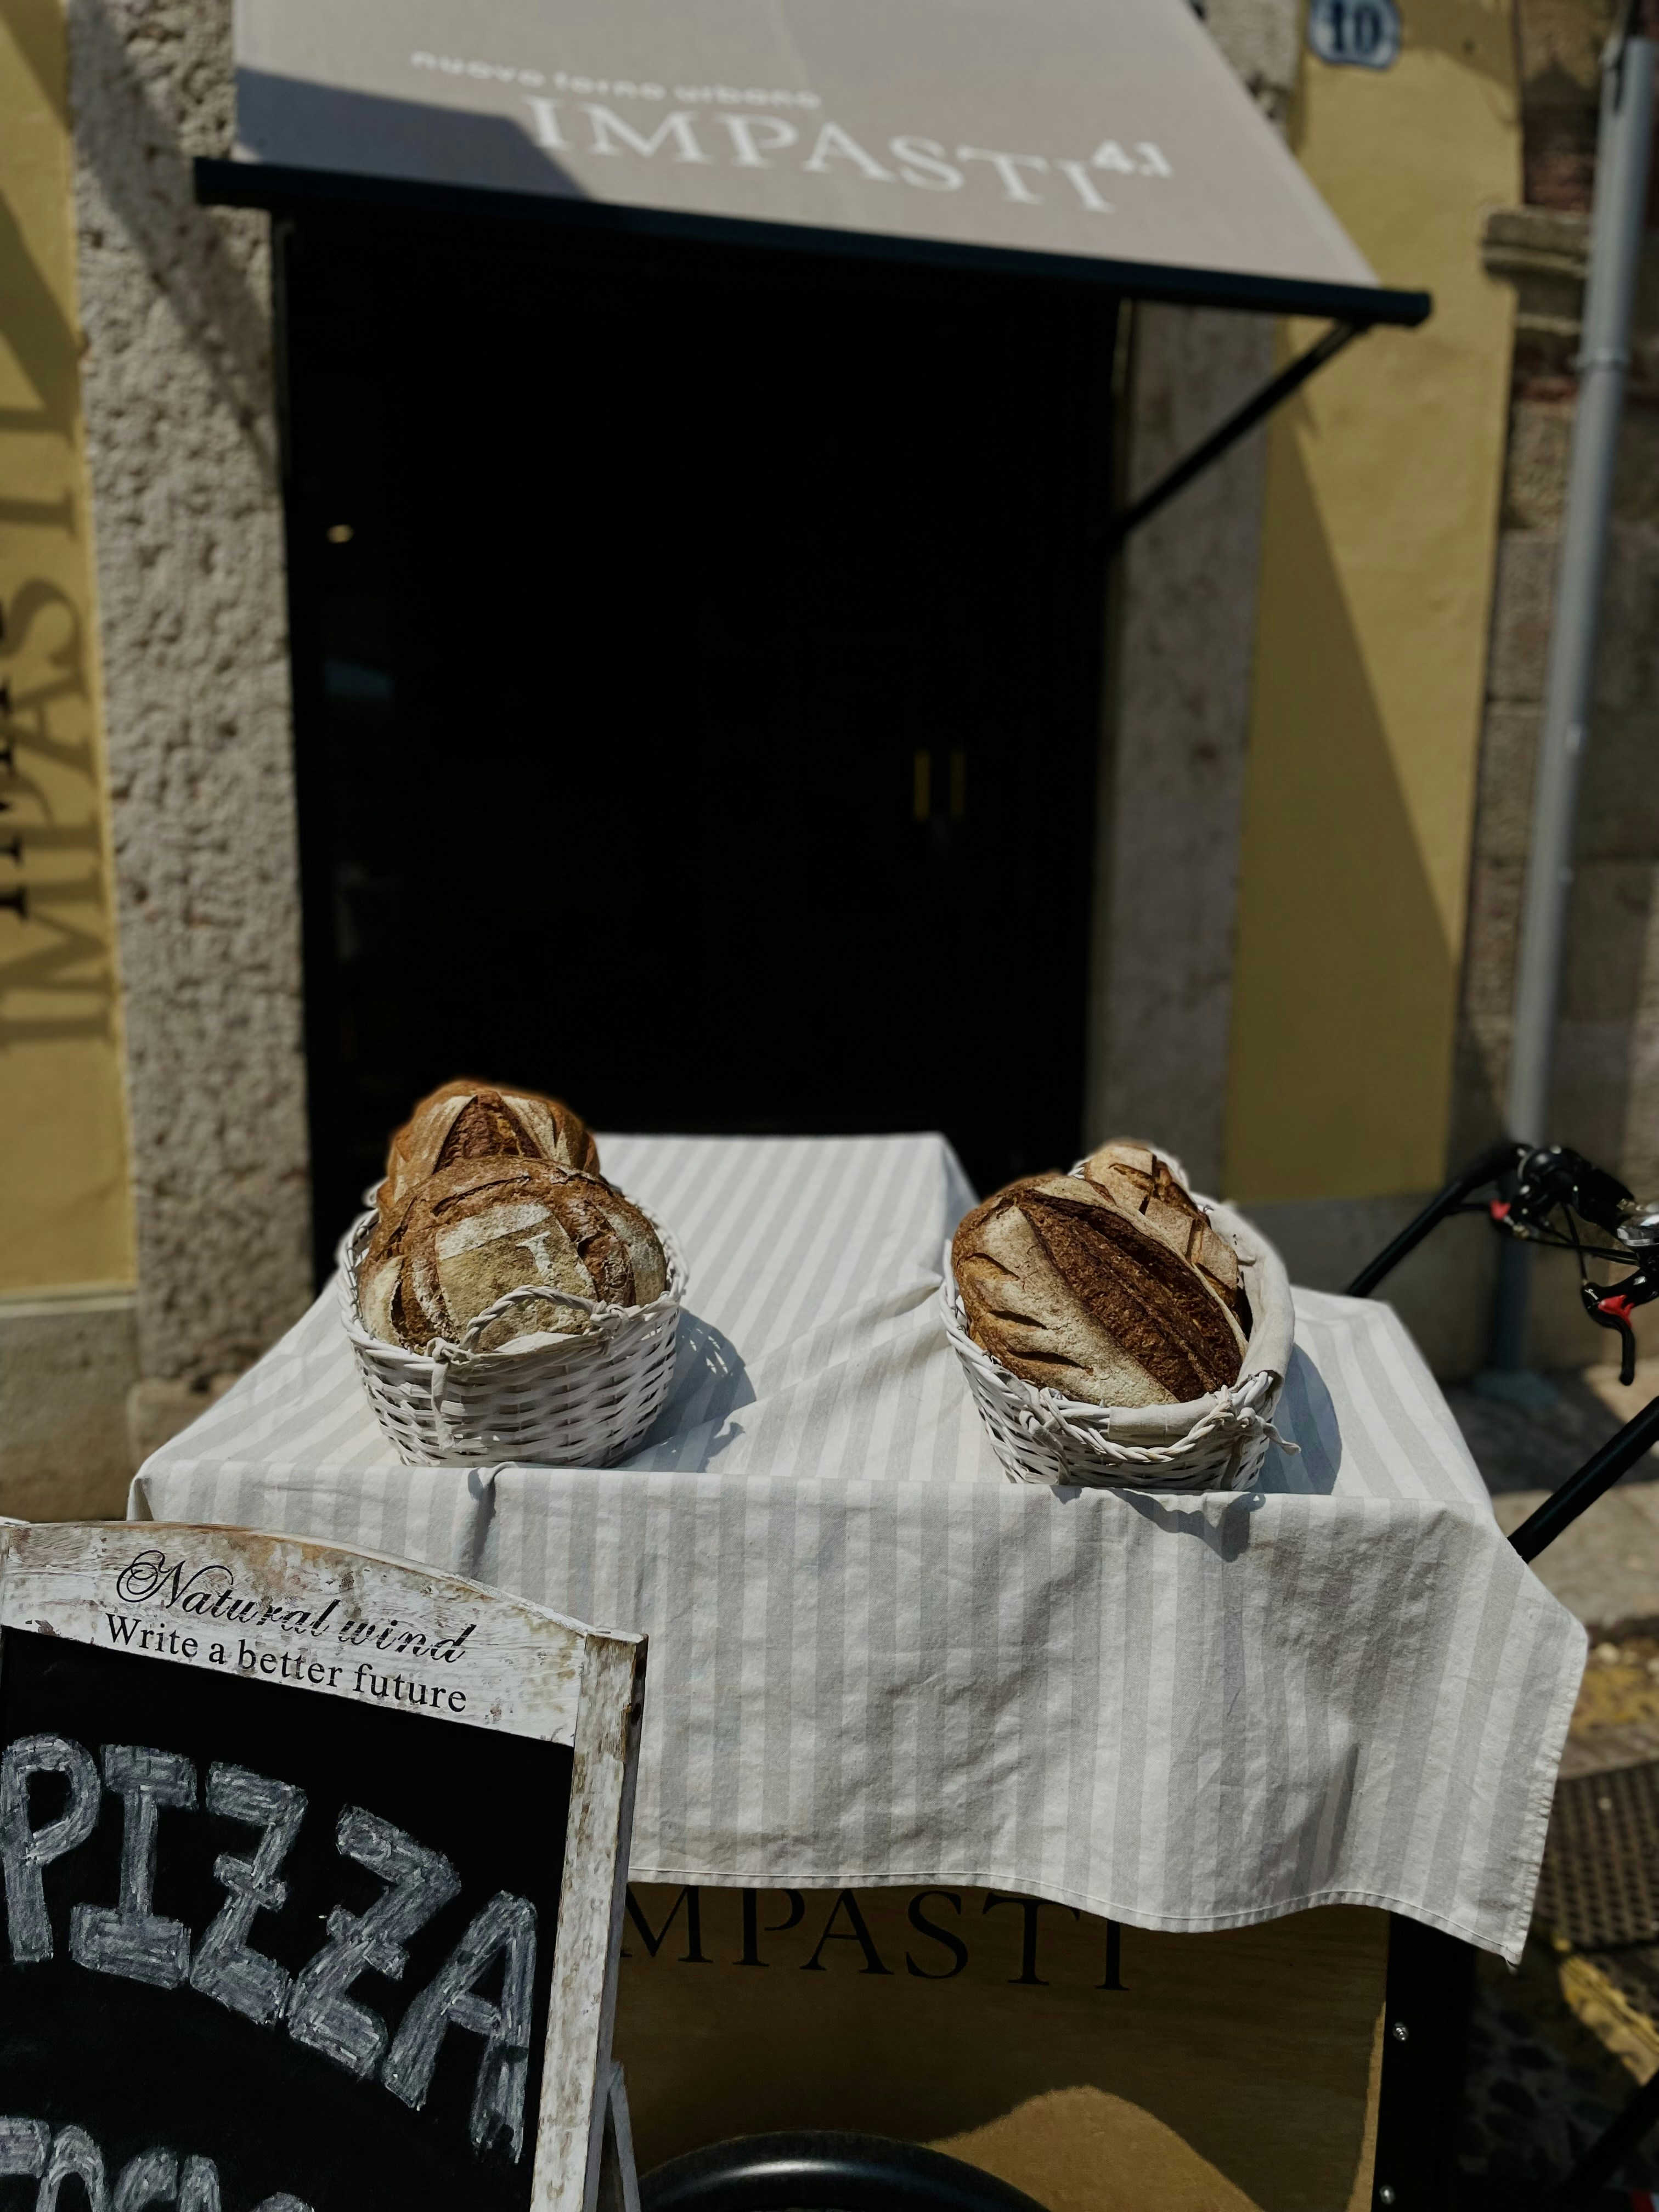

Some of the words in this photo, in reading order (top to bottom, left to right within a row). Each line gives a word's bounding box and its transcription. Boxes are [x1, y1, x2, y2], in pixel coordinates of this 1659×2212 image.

[410, 50, 546, 88] nuovo
[521, 94, 1118, 215] IMPASTI
[105, 1612, 199, 1658] Write
[208, 1642, 225, 1664] a
[238, 1639, 343, 1688] better
[352, 1663, 467, 1712] future
[116, 1549, 341, 1637] Natural
[338, 1618, 477, 1663] wind
[0, 1733, 538, 2164] PIZZA
